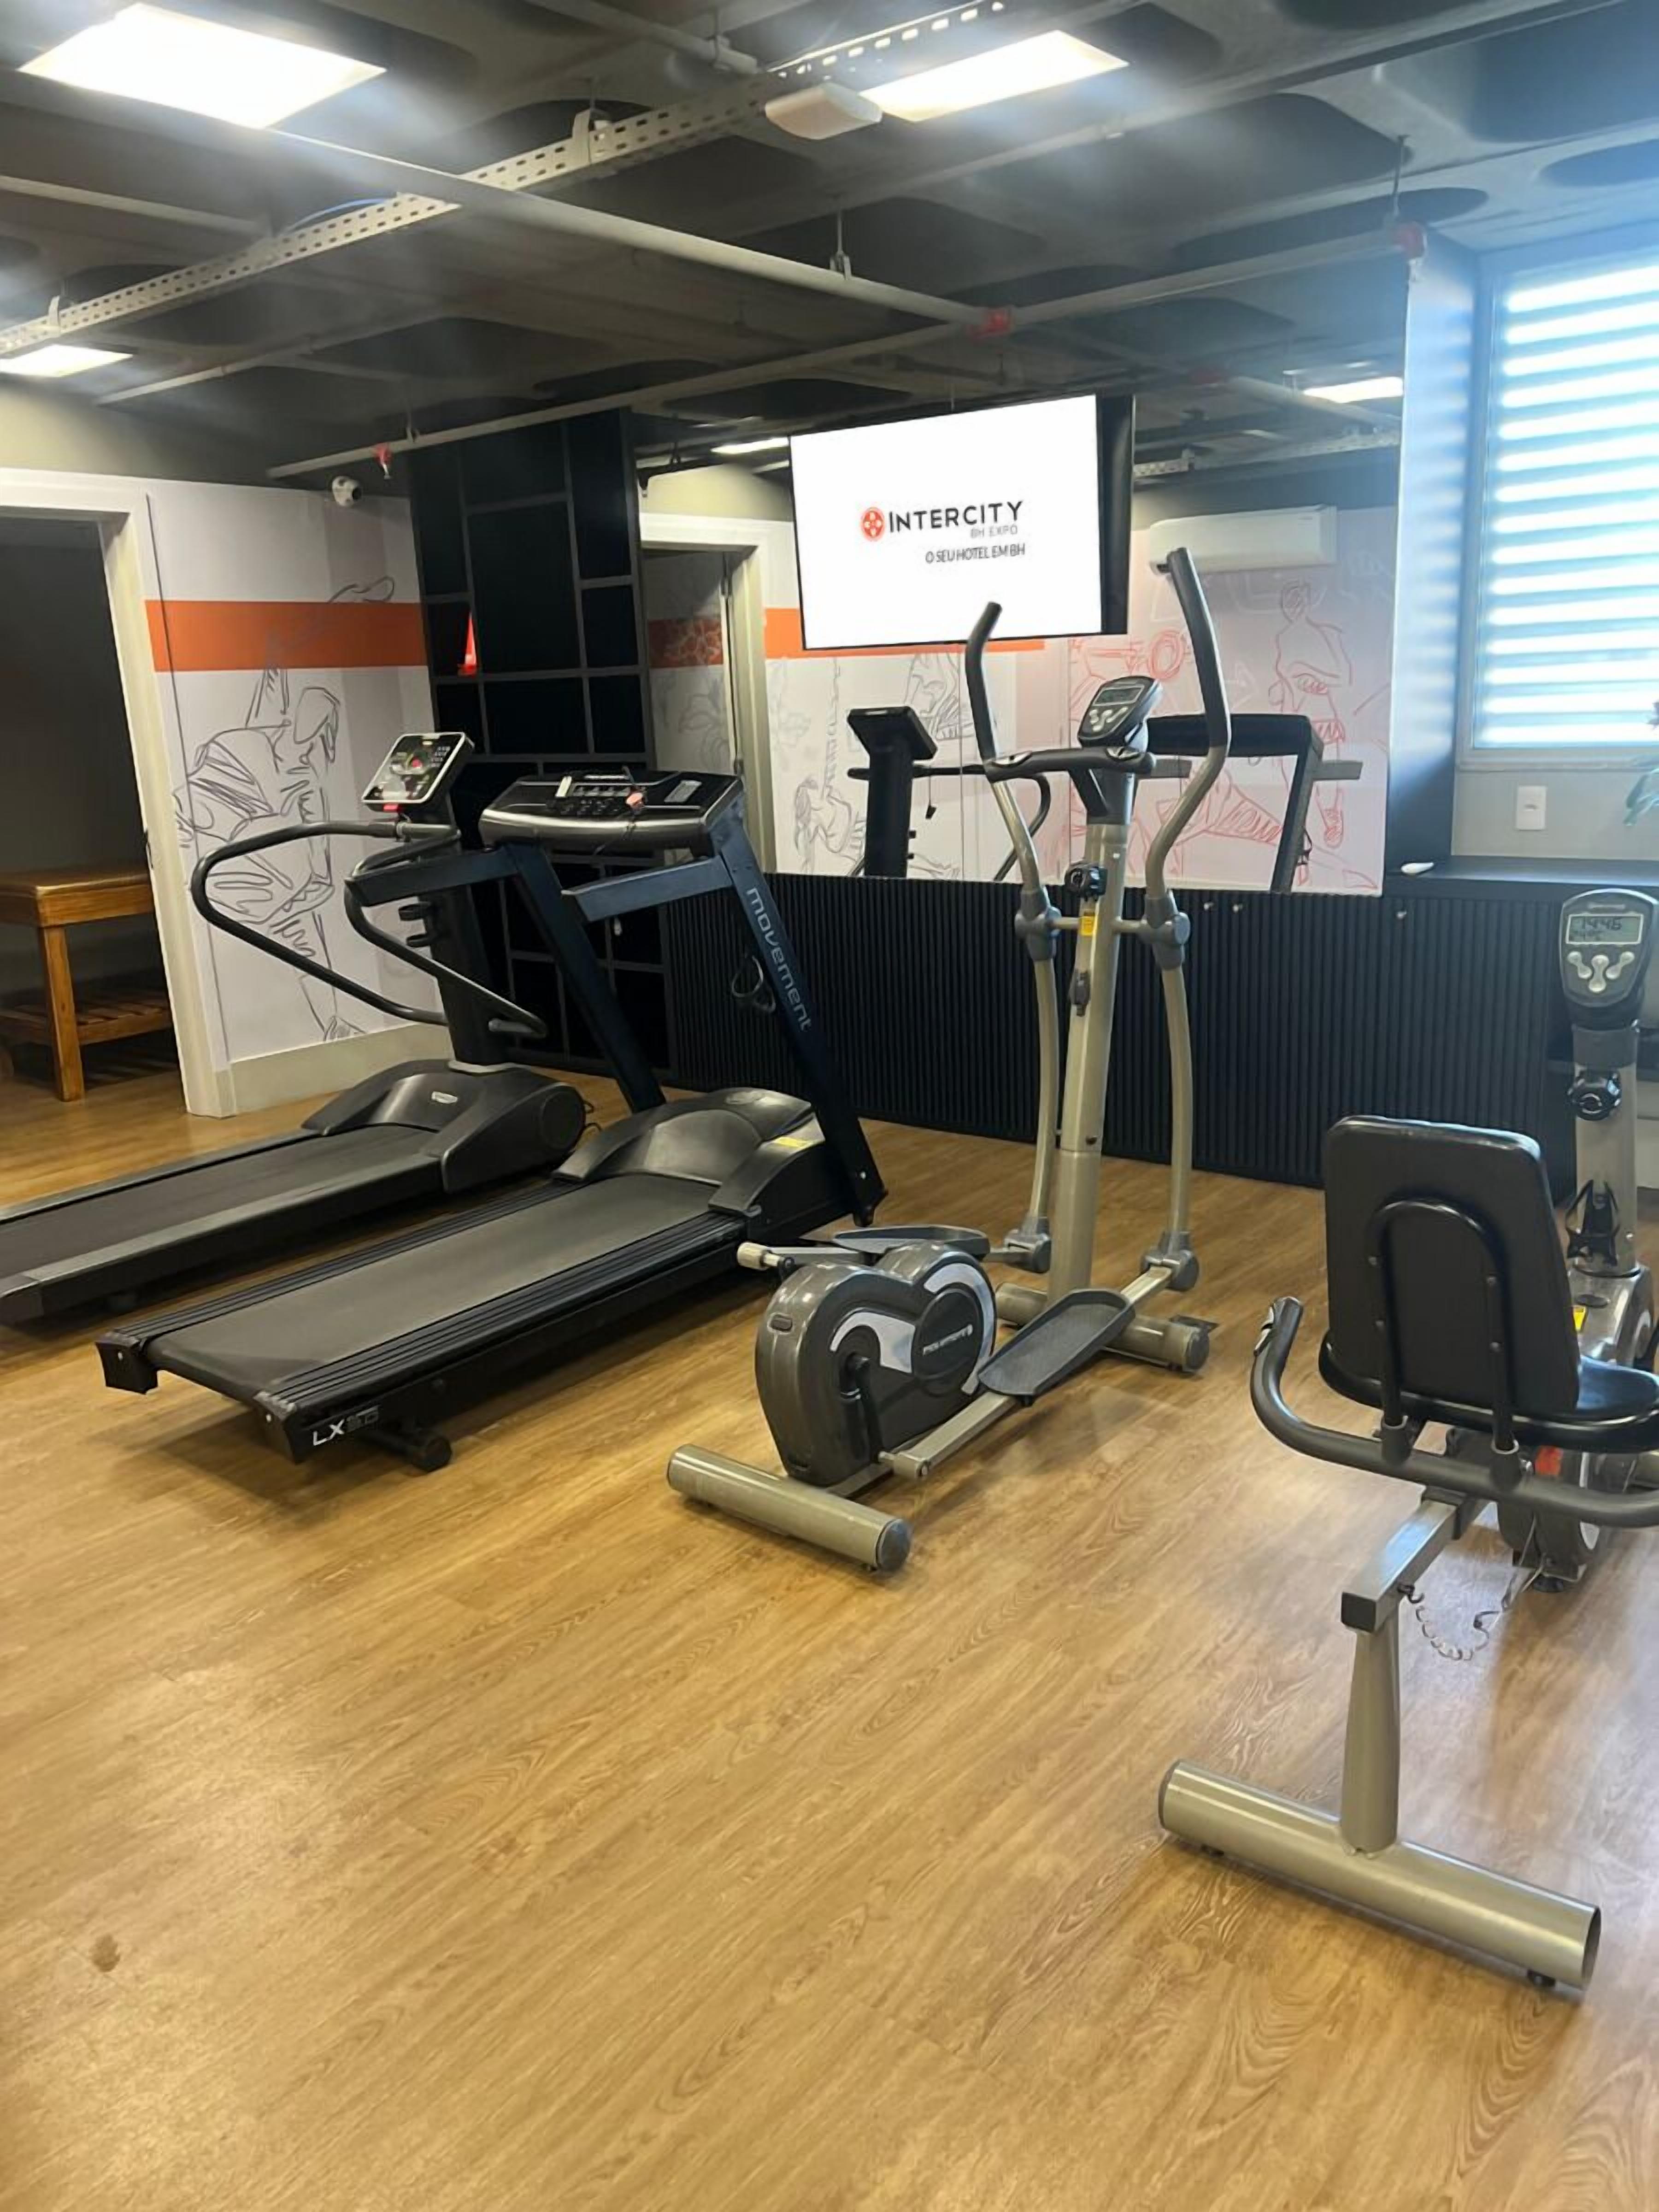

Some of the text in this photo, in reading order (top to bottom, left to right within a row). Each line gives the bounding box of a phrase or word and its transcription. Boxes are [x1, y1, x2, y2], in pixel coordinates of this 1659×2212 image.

[888, 500, 1023, 533] INTERCITY
[925, 551, 935, 564] O
[936, 548, 955, 563] SEU
[956, 546, 990, 561] HOTEL
[1010, 543, 1025, 557] BH
[746, 887, 811, 1032] movement
